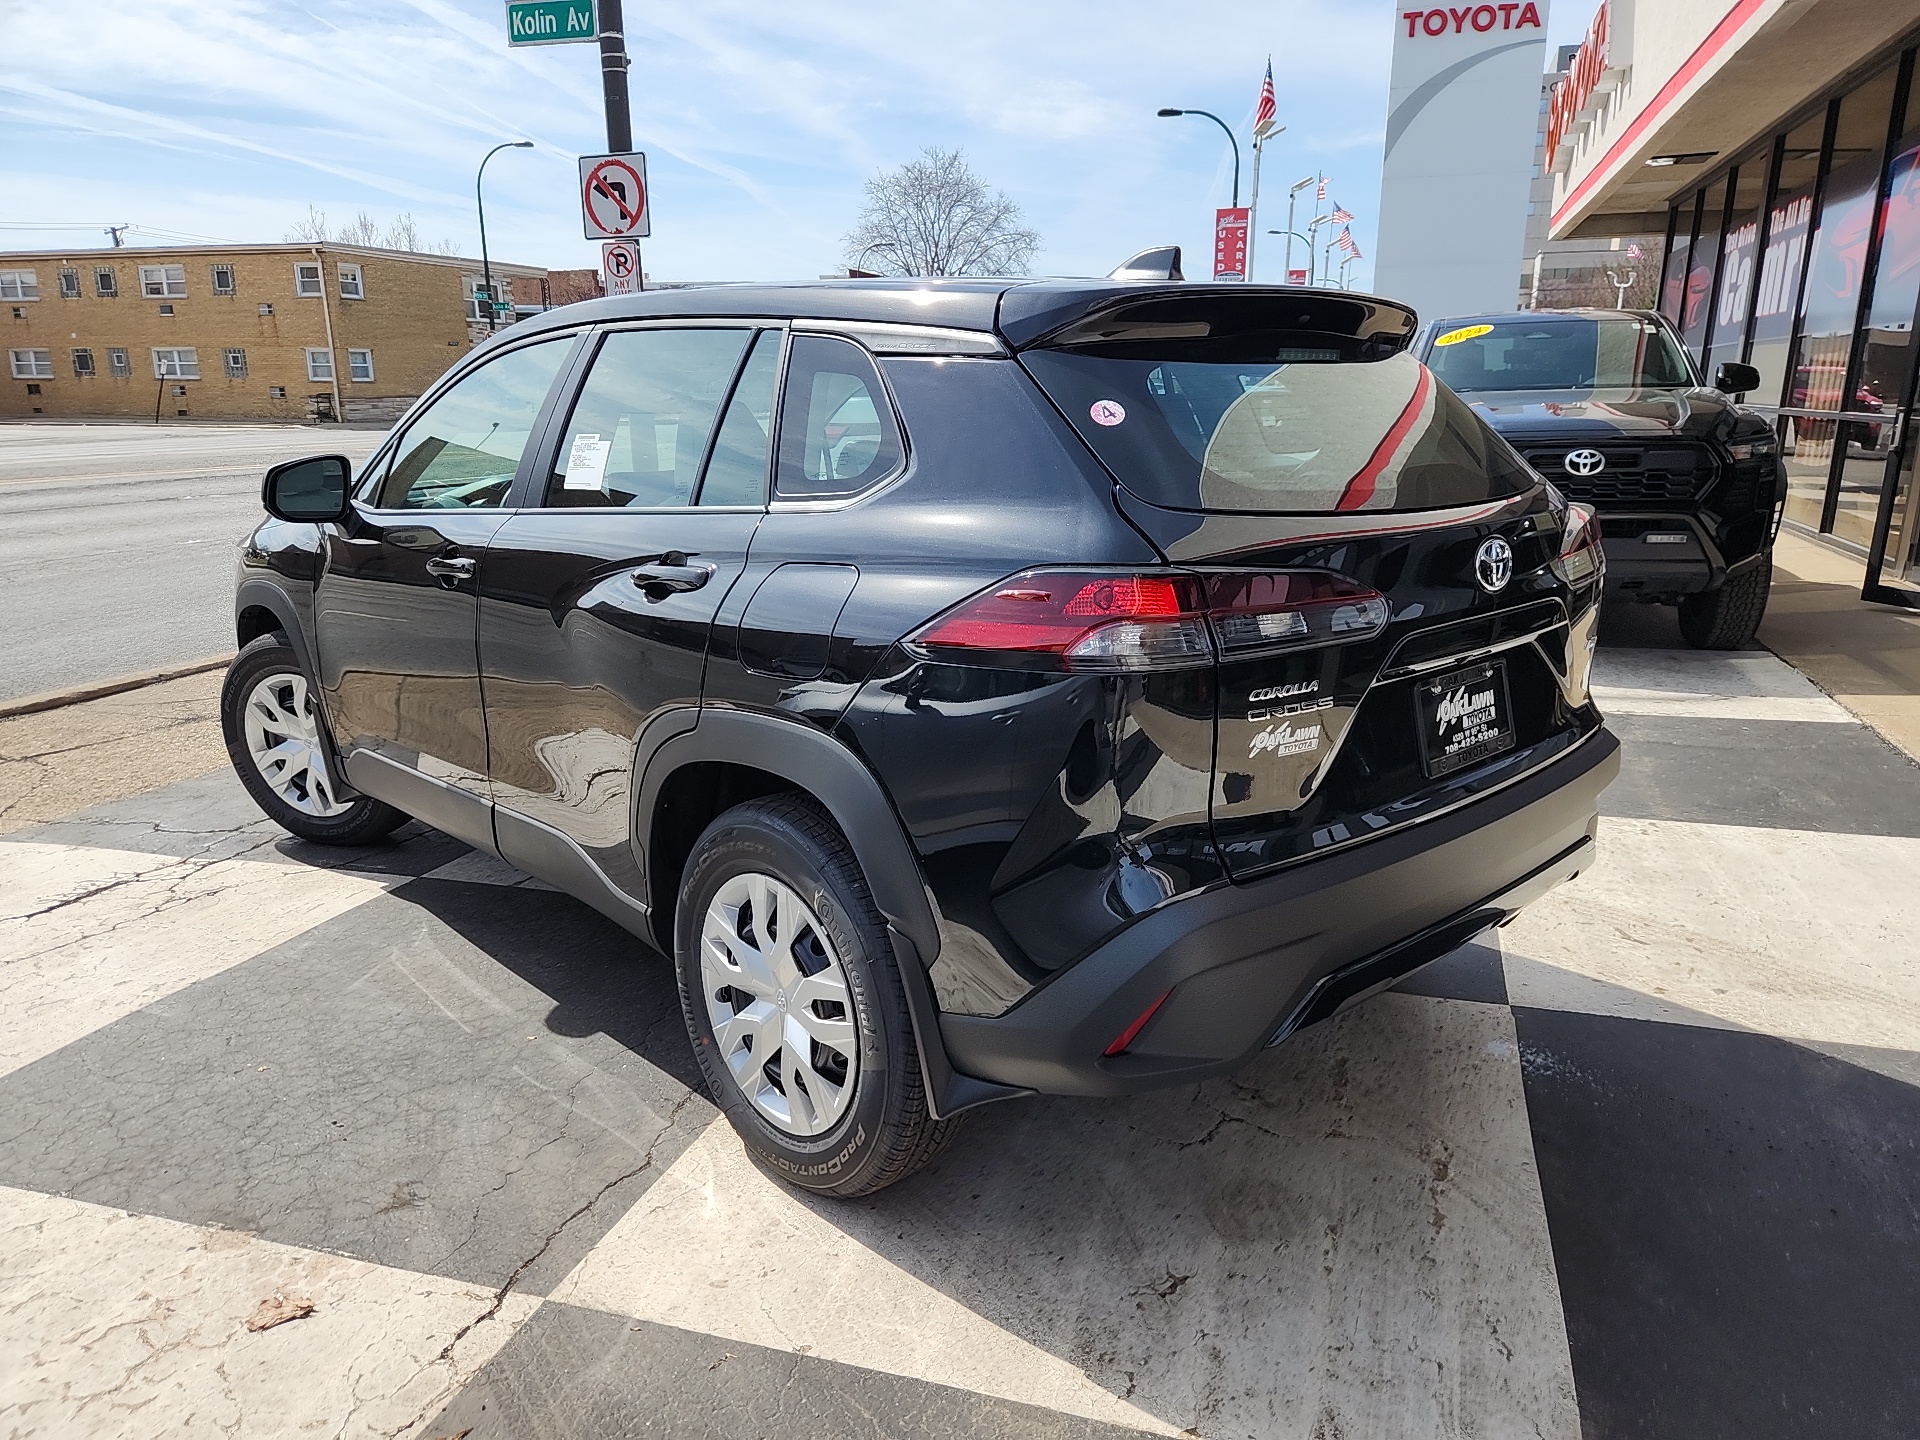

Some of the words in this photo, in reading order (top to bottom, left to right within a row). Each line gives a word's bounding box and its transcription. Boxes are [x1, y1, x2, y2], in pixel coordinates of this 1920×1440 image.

[512, 9, 557, 36] Kolin
[567, 6, 590, 32] Av
[1403, 2, 1541, 38] TOYOTA
[1769, 208, 1785, 236] The
[1784, 200, 1800, 230] All
[1797, 195, 1813, 225] Ne
[1217, 230, 1226, 271] USED
[1235, 229, 1245, 271] CARS
[1724, 231, 1740, 254] Test
[1738, 222, 1757, 248] Drive
[614, 279, 631, 290] ANY
[1719, 228, 1821, 326] Camry
[1446, 326, 1482, 343] 2024
[1248, 680, 1320, 702] COROLLA
[1247, 696, 1334, 723] CROSS
[1465, 708, 1494, 727] TOYOTA
[1283, 741, 1314, 753] TOYOTA
[1444, 727, 1499, 755] 708-423-5200
[1457, 743, 1489, 763] TOYOTA
[768, 1122, 866, 1176] PROCONTACT
